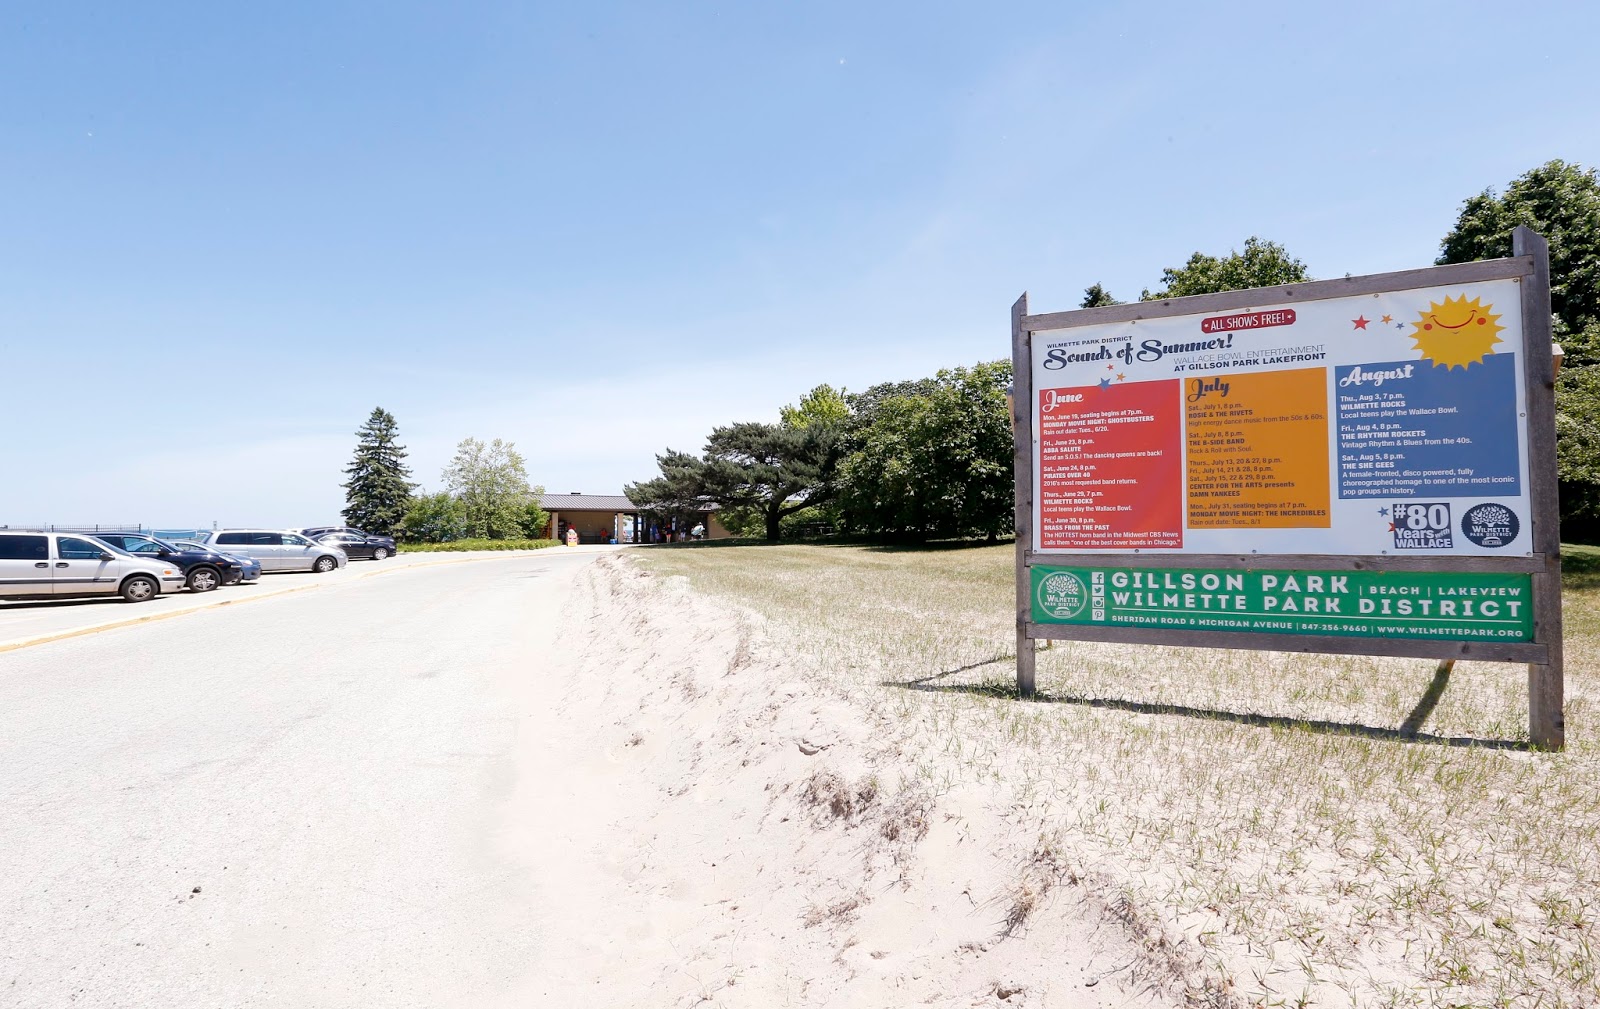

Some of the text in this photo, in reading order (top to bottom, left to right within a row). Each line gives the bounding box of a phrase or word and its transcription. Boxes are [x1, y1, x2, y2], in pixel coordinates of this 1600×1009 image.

[1210, 313, 1285, 331] ALL SHOWS FREE!
[1043, 334, 1233, 370] Sounds of Summer!
[1173, 344, 1325, 365] WALLACE BOWL ENTERTAINMENT
[1188, 361, 1230, 371] GILLSON
[1232, 359, 1260, 367] PARK
[1263, 353, 1326, 365] LAKEFRONT
[1339, 364, 1414, 387] August
[1187, 378, 1230, 402] July
[1042, 390, 1084, 412] June
[1359, 394, 1373, 402] Aug
[1340, 402, 1379, 410] WILMETTE
[1080, 412, 1100, 420] seating
[1101, 410, 1119, 418] begins
[1380, 410, 1395, 418] play
[1107, 415, 1154, 424] GHOSTBUSTERS
[1189, 420, 1202, 428] High
[1356, 424, 1370, 432] Aug
[1203, 431, 1217, 439] July
[1391, 430, 1426, 438] ROCKETS
[1341, 441, 1367, 450] Vintage
[1368, 440, 1395, 449] Rhythm
[1093, 452, 1115, 460] dancing
[1359, 454, 1374, 462] Aug
[1202, 467, 1215, 475] July
[1349, 470, 1401, 478] female-fronted,
[1422, 469, 1456, 477] powered,
[1457, 469, 1474, 477] fully
[1075, 479, 1101, 487] requested
[1204, 475, 1217, 483] July
[1342, 479, 1393, 488] choreographed
[1394, 478, 1422, 487] homage
[1264, 481, 1295, 489] presents
[1390, 487, 1416, 495] history.
[1256, 502, 1277, 510] begins
[1395, 528, 1434, 538] Years
[1396, 539, 1451, 548] WALLACE
[1111, 572, 1521, 596] GILLSON PARK BEACH LAKEVIEW
[1046, 595, 1078, 603] WILMETTE
[1111, 592, 1522, 617] WILMETTE PARK DISTRICT
[1111, 615, 1157, 624] SHERIDAN
[1160, 617, 1187, 625] ROAD
[1199, 619, 1250, 627] MICHIGAN
[1253, 621, 1293, 629] AVENUE
[1301, 623, 1368, 632] 847-256-9660
[1377, 626, 1523, 637] WWW.WILMETTEPARK.ORG
